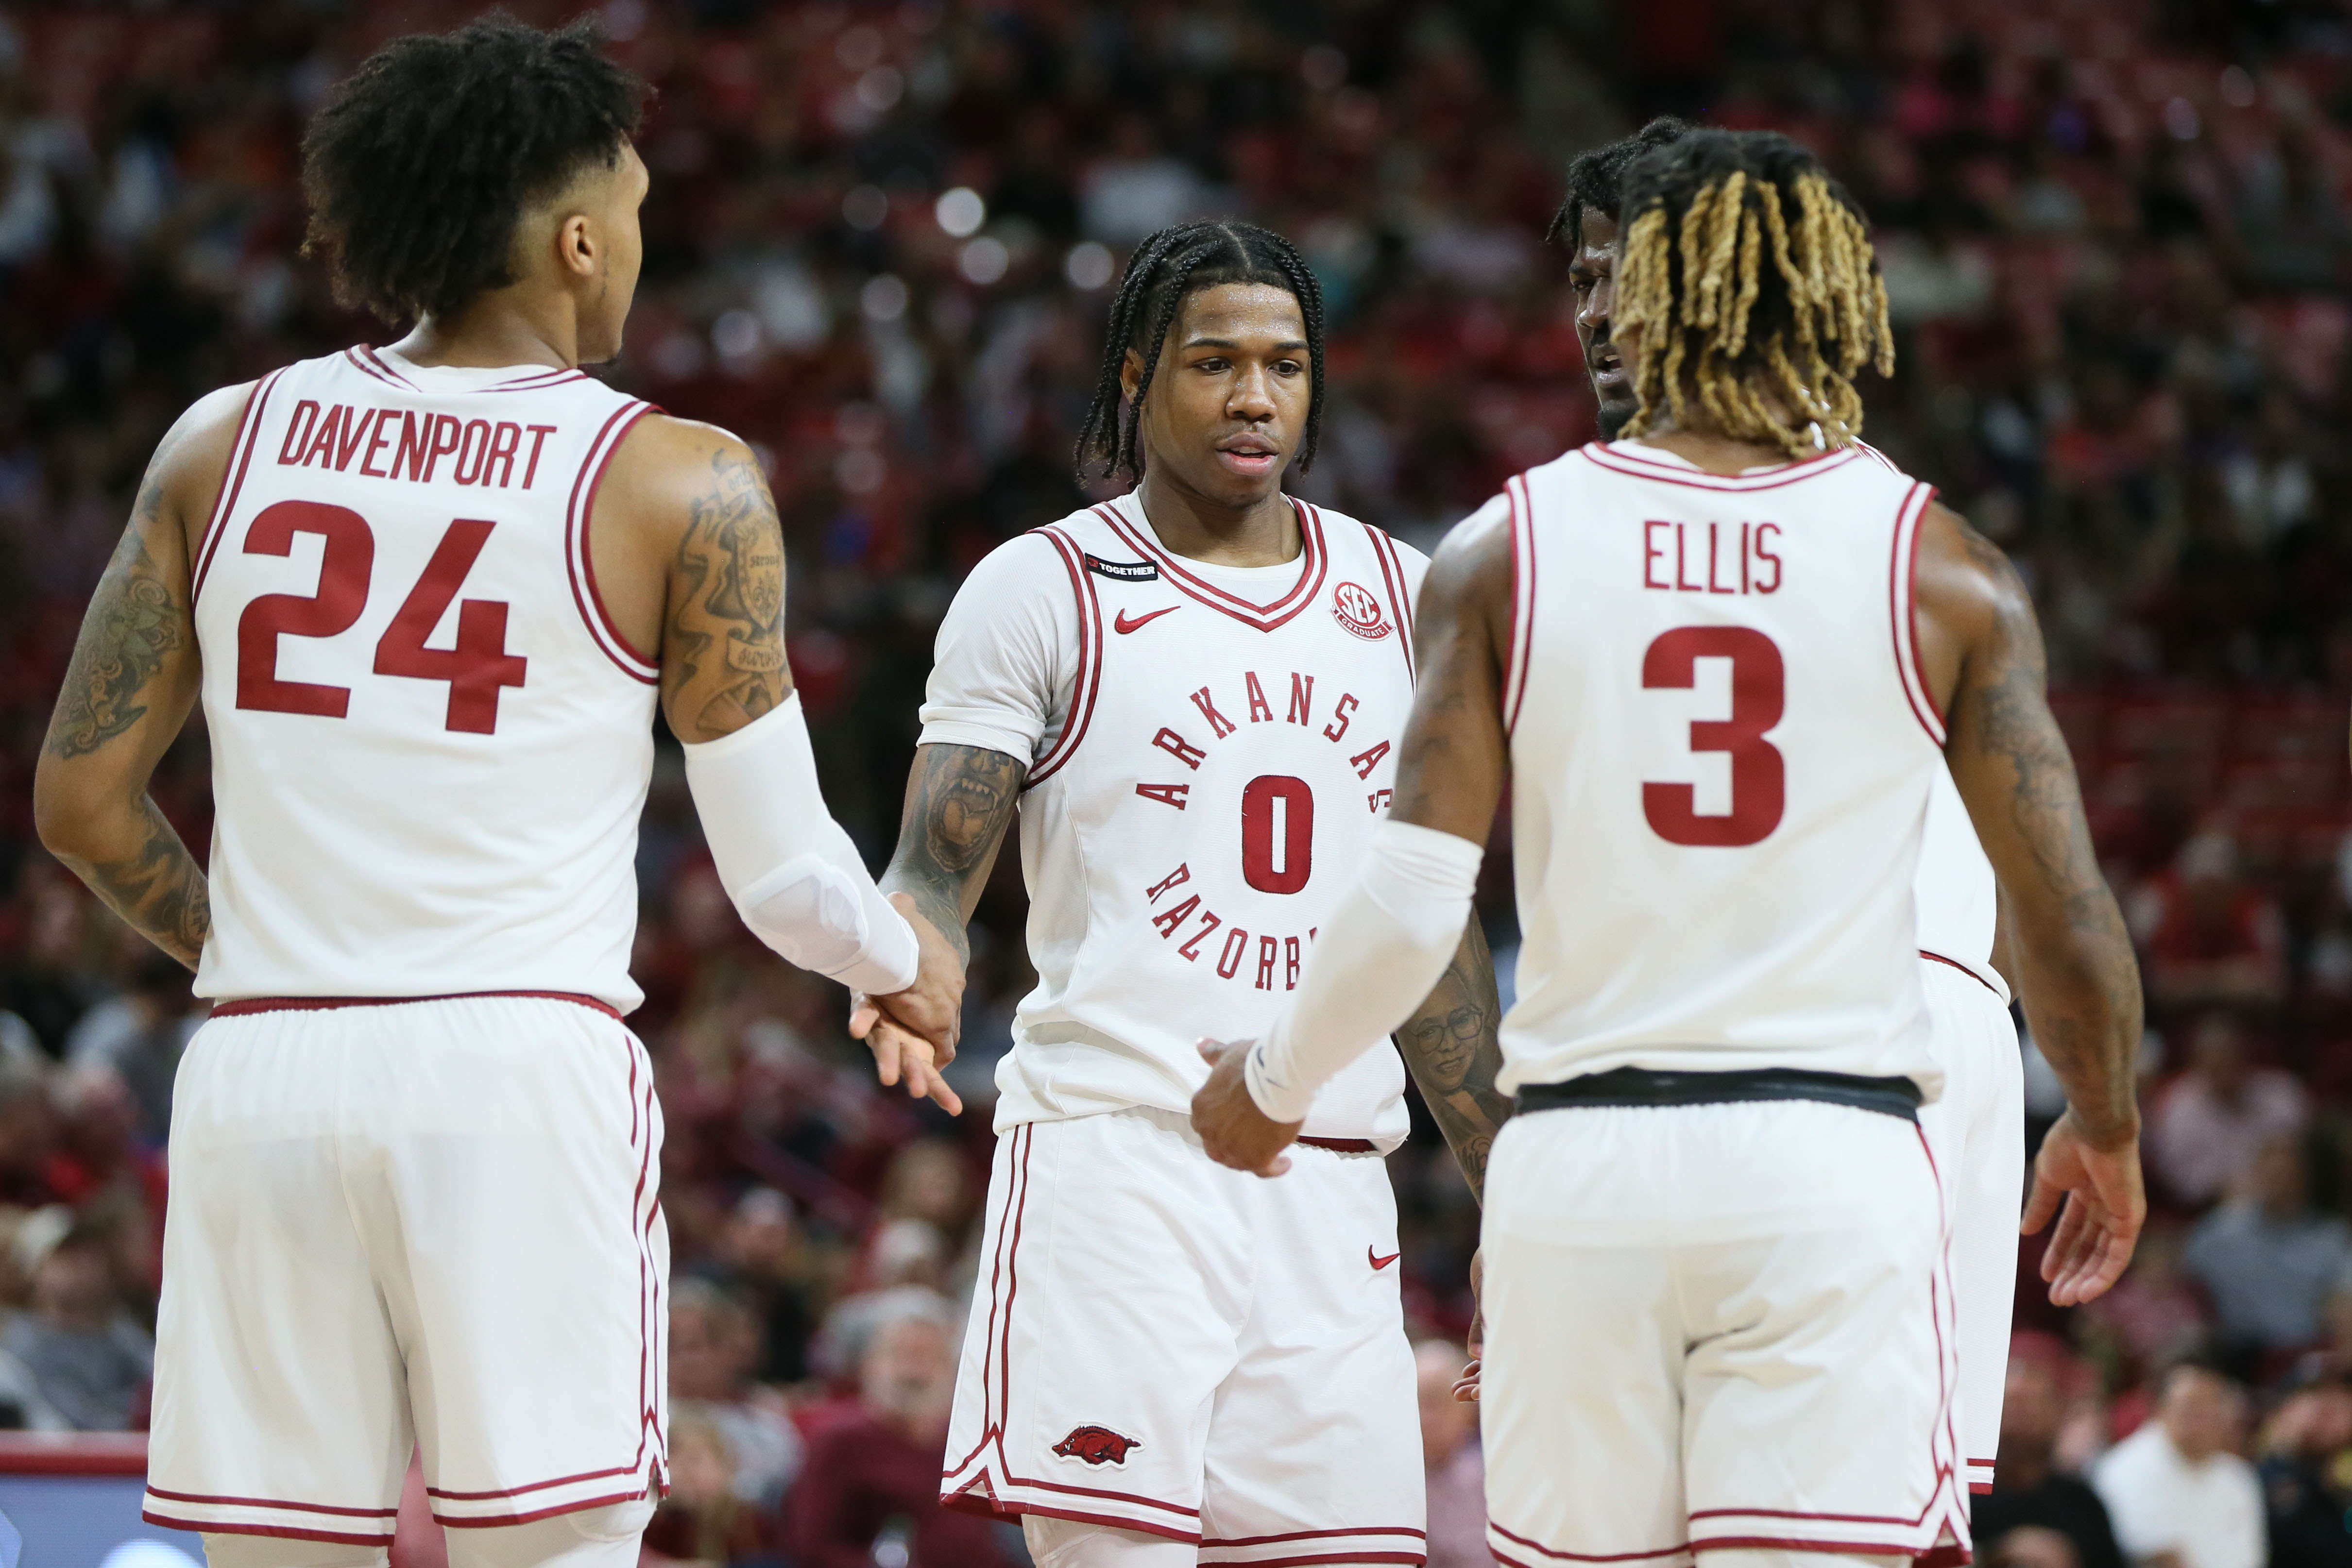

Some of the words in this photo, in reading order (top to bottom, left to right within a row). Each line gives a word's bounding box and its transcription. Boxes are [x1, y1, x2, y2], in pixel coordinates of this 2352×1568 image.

[278, 400, 557, 489] DAVENPORT
[1099, 563, 1155, 575] TOGETHER
[1338, 584, 1378, 624] SEC
[1644, 520, 1782, 594] ELLIS
[236, 500, 528, 735] 24
[1341, 618, 1385, 637] GRADUATE
[1135, 671, 1393, 813] ARKANSAS
[1641, 625, 1786, 848] 3
[1242, 775, 1314, 894] 0
[1146, 862, 1318, 991] RAZORB
